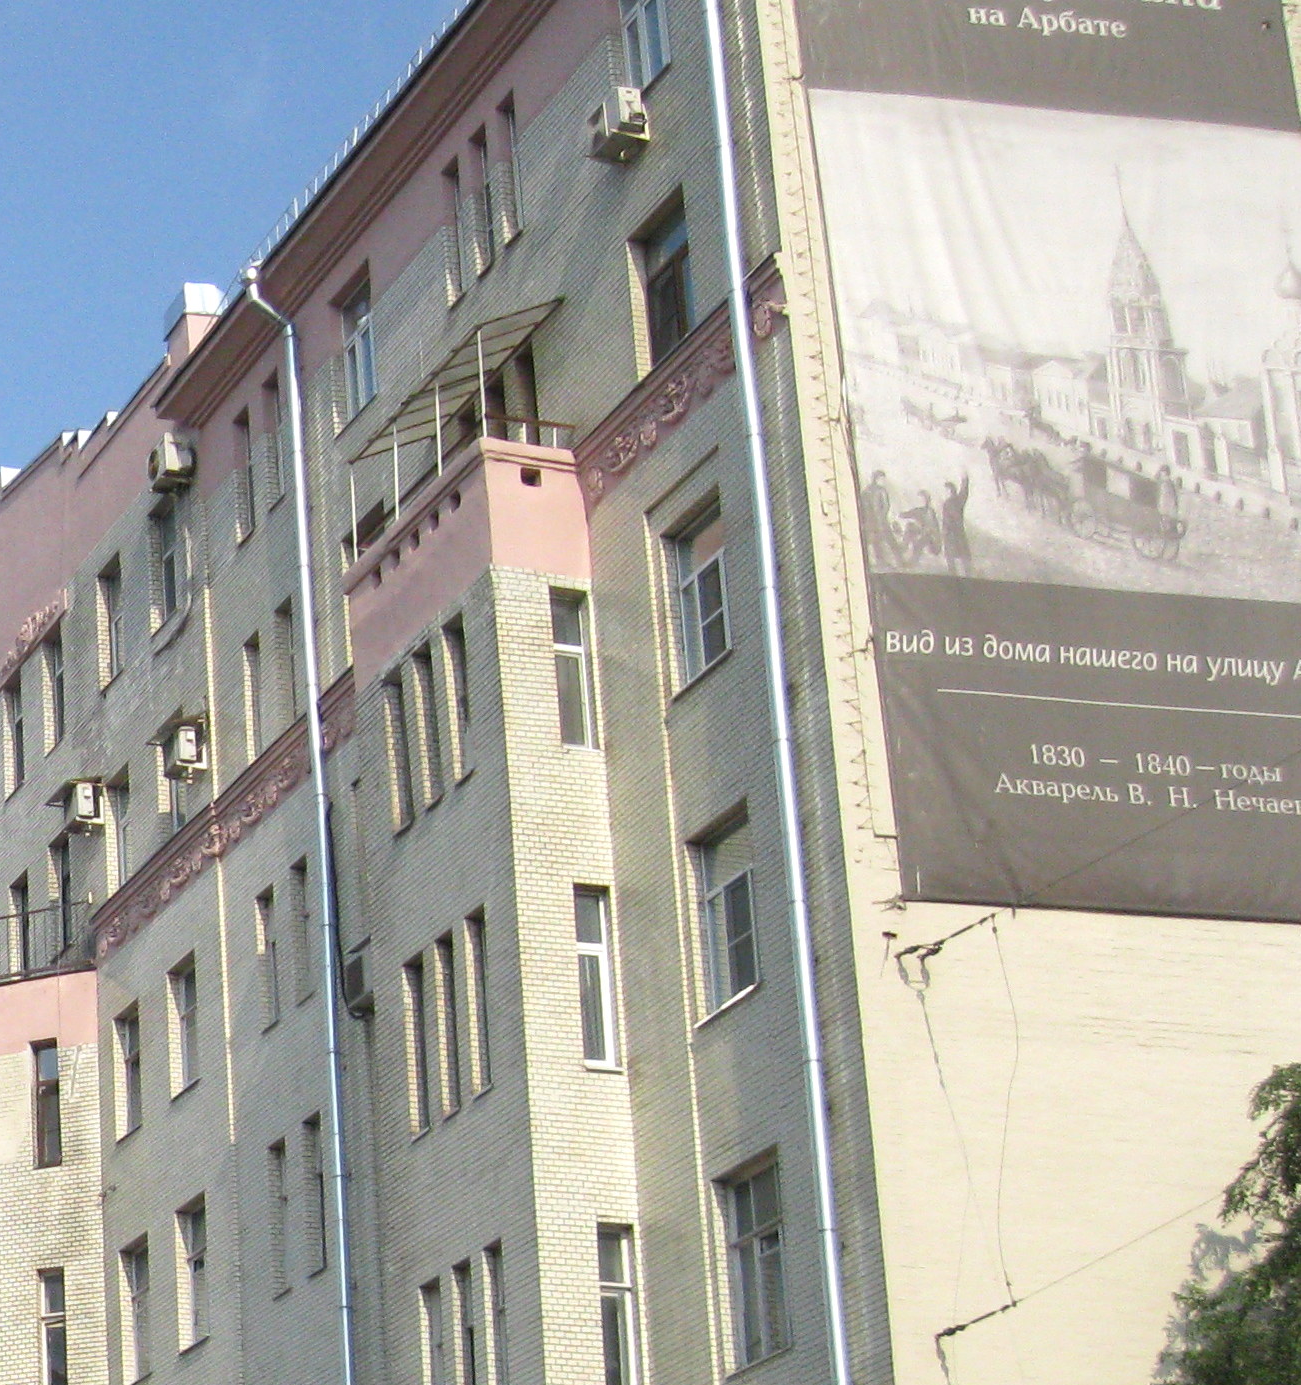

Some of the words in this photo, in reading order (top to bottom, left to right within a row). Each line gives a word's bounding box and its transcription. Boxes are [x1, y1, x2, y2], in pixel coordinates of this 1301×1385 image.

[968, 7, 1007, 27] на
[1016, 6, 1128, 38] Арбате
[944, 635, 974, 657] из
[982, 633, 1051, 664] дома
[1059, 645, 1158, 672] нашего
[1166, 654, 1199, 675] на
[1205, 656, 1285, 686] улицу
[1029, 743, 1086, 769] 1830
[1134, 752, 1191, 777] 1840
[994, 772, 1120, 805] Акварель
[1126, 783, 1153, 807] В.
[1168, 786, 1198, 810] Н.
